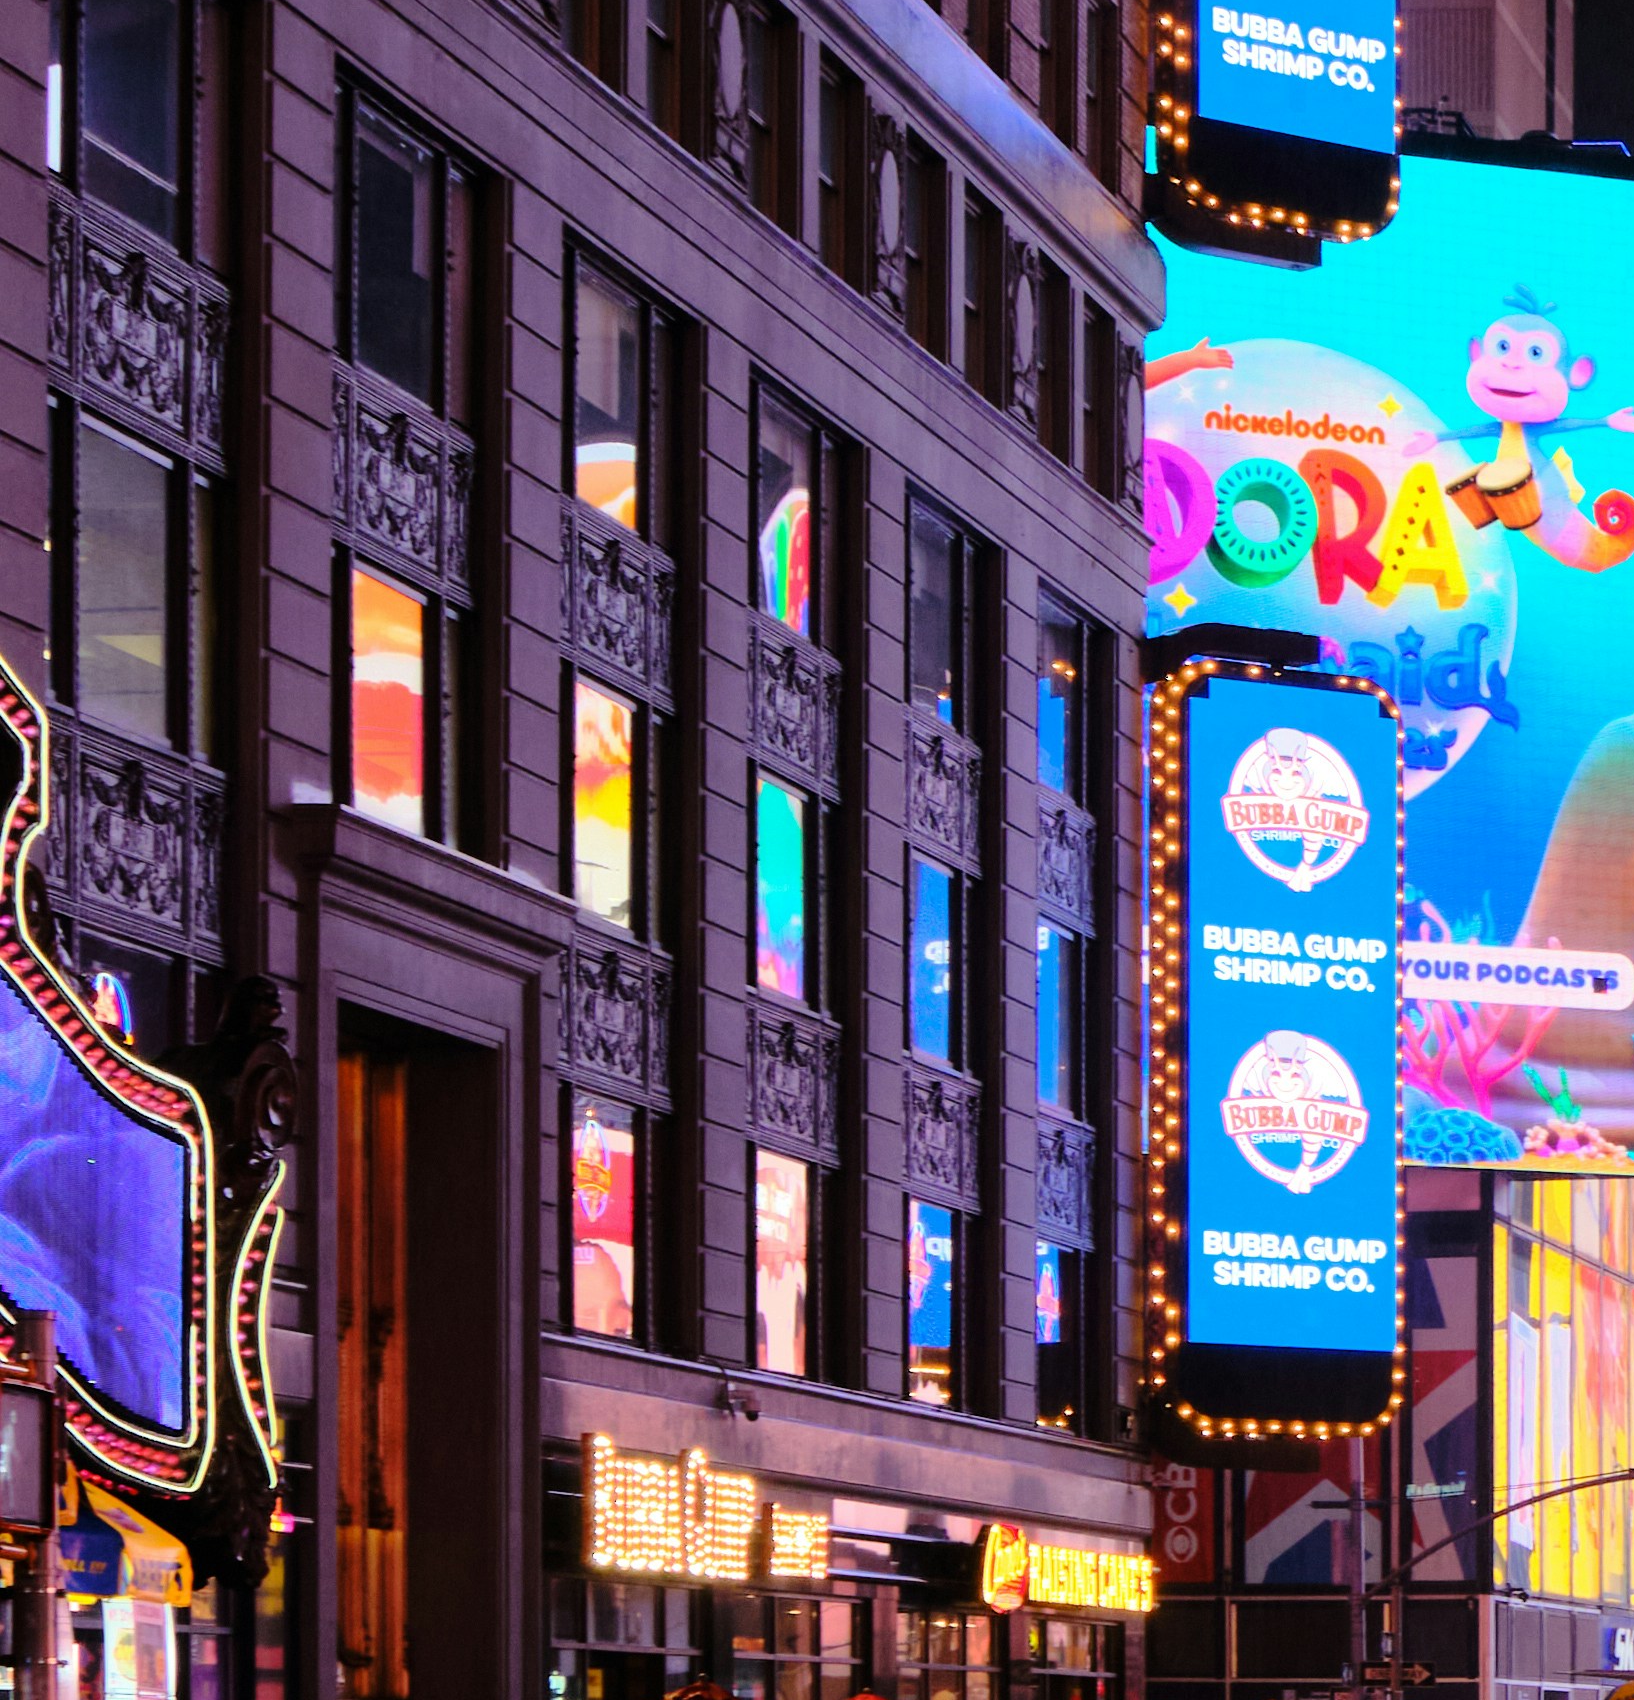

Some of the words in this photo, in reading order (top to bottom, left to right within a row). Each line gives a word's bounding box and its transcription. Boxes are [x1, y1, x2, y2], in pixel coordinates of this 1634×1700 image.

[1212, 6, 1304, 49] BUBBA
[1308, 27, 1386, 64] GUMP
[1222, 39, 1324, 80] SHRIMP
[1328, 61, 1375, 92] CO.
[1205, 404, 1386, 445] nickelodeon
[1144, 438, 1469, 611] DORA
[1203, 925, 1301, 957] BUBBA
[1304, 934, 1387, 964] GUMP
[1214, 956, 1321, 987] SHRIMP
[1325, 965, 1376, 992] CO.
[1476, 963, 1619, 990] PODCASTS
[1203, 1230, 1301, 1260] BUBBA
[1304, 1236, 1387, 1264] GUMP
[1213, 1260, 1320, 1289] SHRIMP
[1325, 1266, 1375, 1293] CO.
